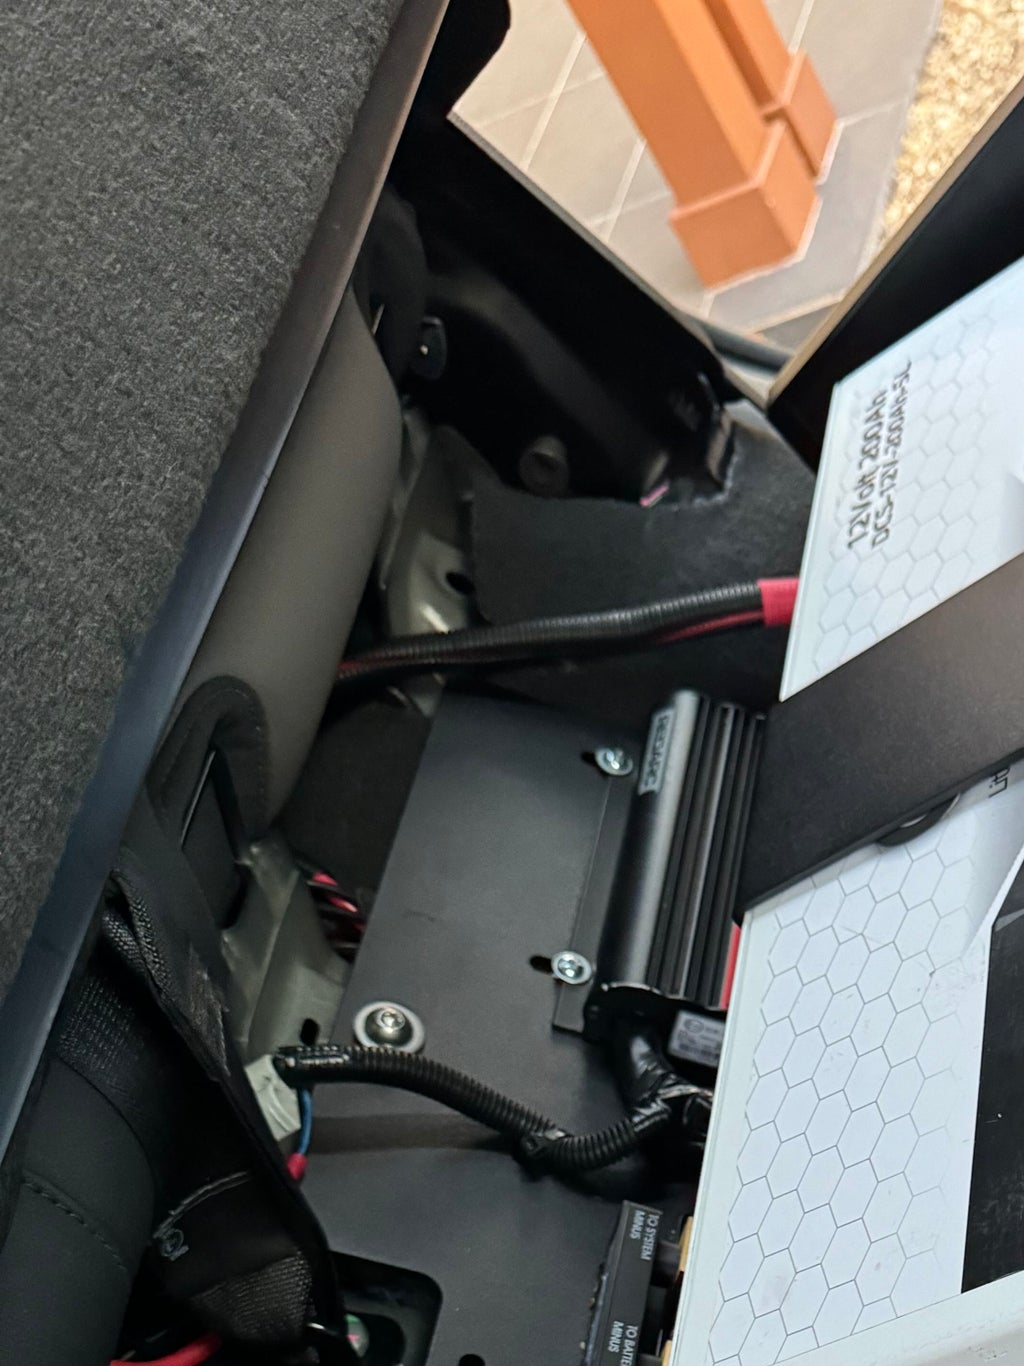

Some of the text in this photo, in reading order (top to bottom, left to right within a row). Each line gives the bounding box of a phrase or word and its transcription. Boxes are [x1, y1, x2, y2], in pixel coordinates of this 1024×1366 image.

[858, 390, 888, 470] 200Ah
[629, 1209, 645, 1240] MINUS
[640, 1214, 660, 1261] TO SYSTEM
[608, 1320, 625, 1353] MINUS
[625, 1324, 639, 1338] TO
